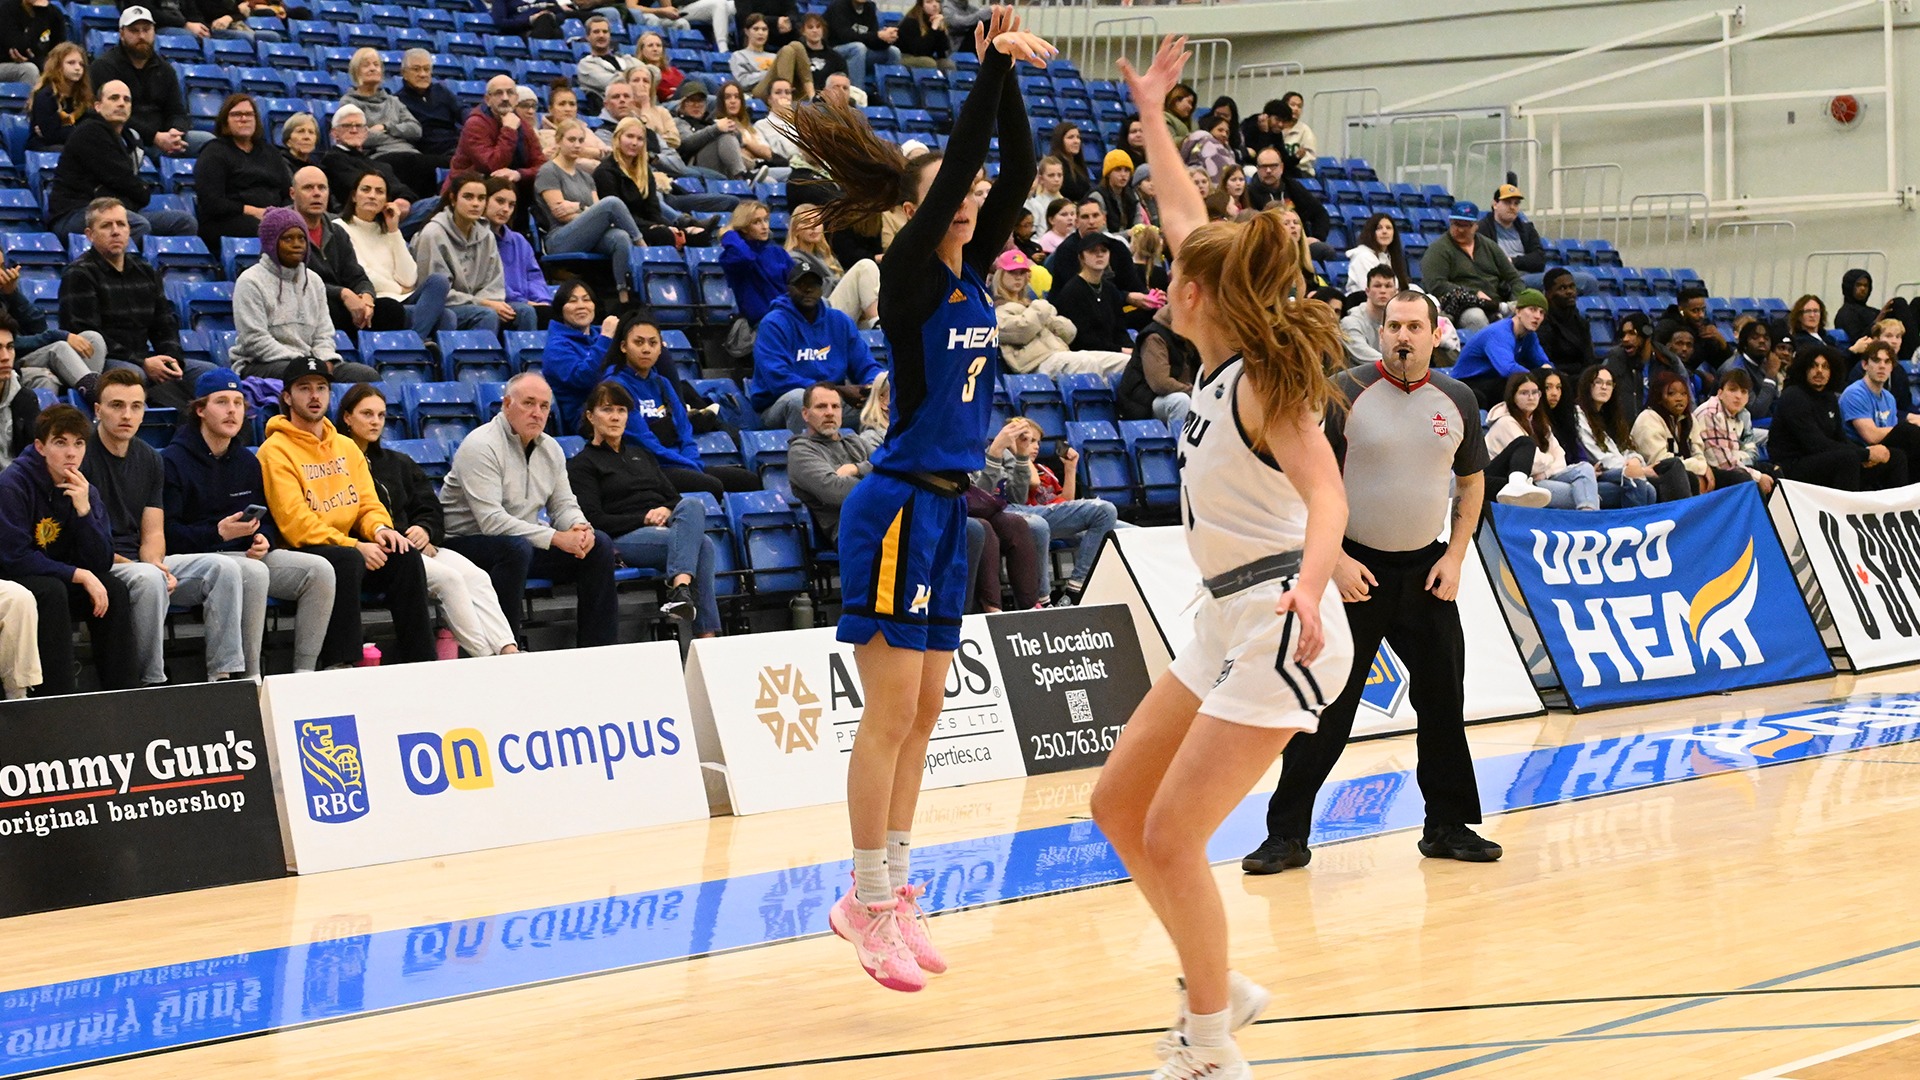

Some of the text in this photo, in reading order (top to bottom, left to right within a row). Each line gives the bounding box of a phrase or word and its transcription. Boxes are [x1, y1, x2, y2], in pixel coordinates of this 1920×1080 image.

[947, 326, 999, 350] HEA
[962, 356, 987, 402] 3
[1529, 519, 1676, 585] UBCO
[1819, 510, 1881, 640] U
[1551, 540, 1765, 687] HEAT
[1006, 628, 1114, 657] The Location
[1032, 656, 1108, 692] Specialist
[0, 730, 257, 797] ommy Gun's
[406, 716, 681, 787] on campus
[1030, 724, 1127, 760] 250.763.67
[0, 790, 245, 837] original barbershop
[312, 790, 365, 817] RBC
